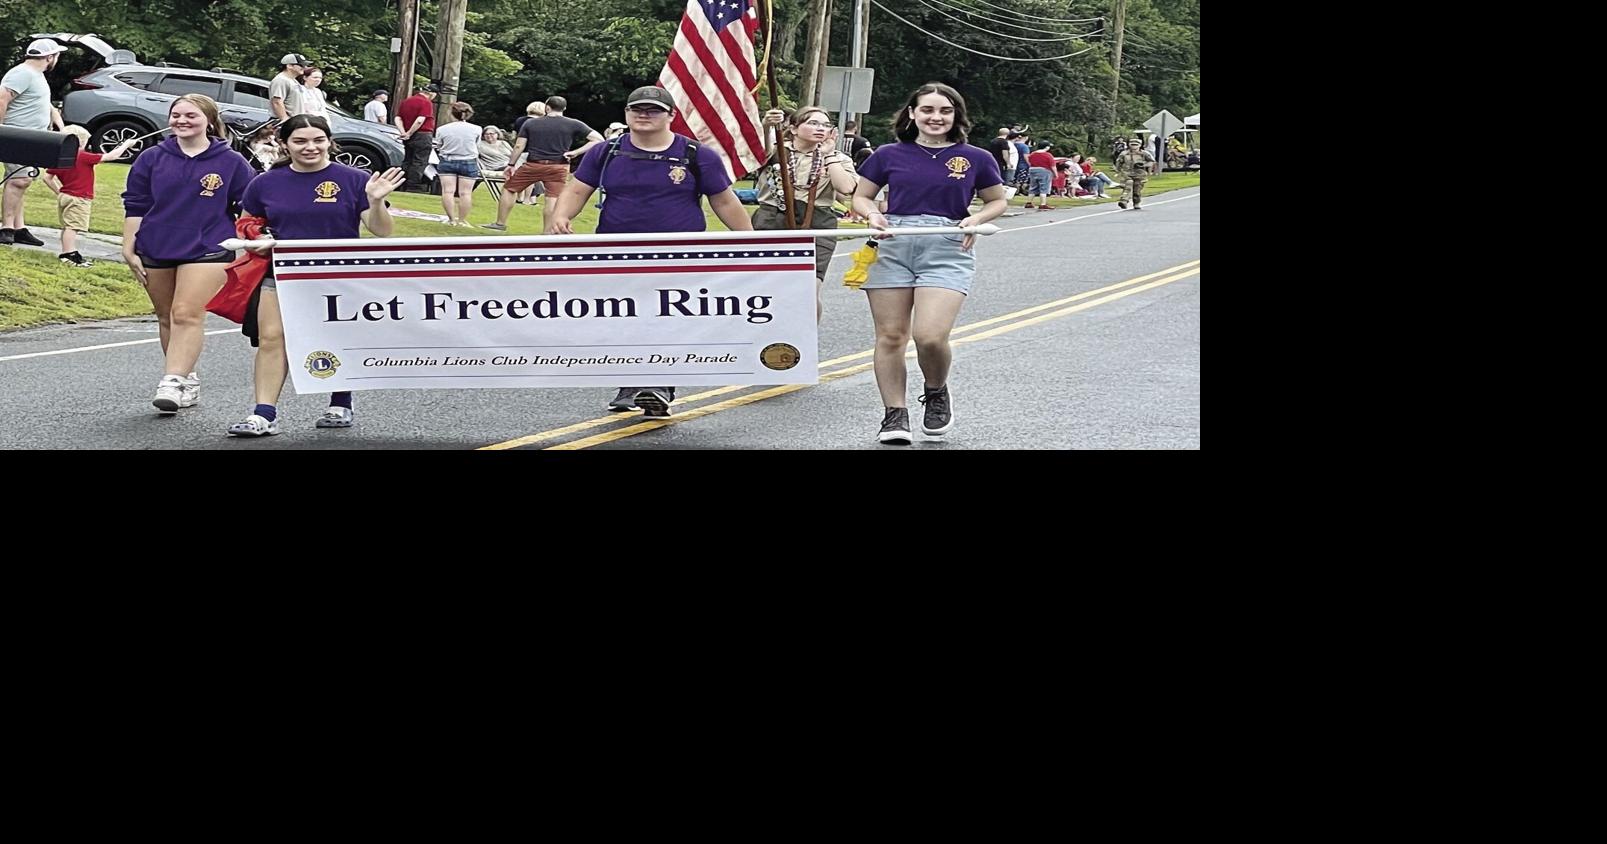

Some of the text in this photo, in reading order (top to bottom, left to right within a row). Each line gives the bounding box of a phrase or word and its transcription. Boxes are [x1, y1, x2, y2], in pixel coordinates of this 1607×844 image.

[323, 288, 774, 324] Let Freedom Ring
[317, 359, 328, 370] L
[362, 353, 738, 368] Columbia Lions Club Independence Day Parade
